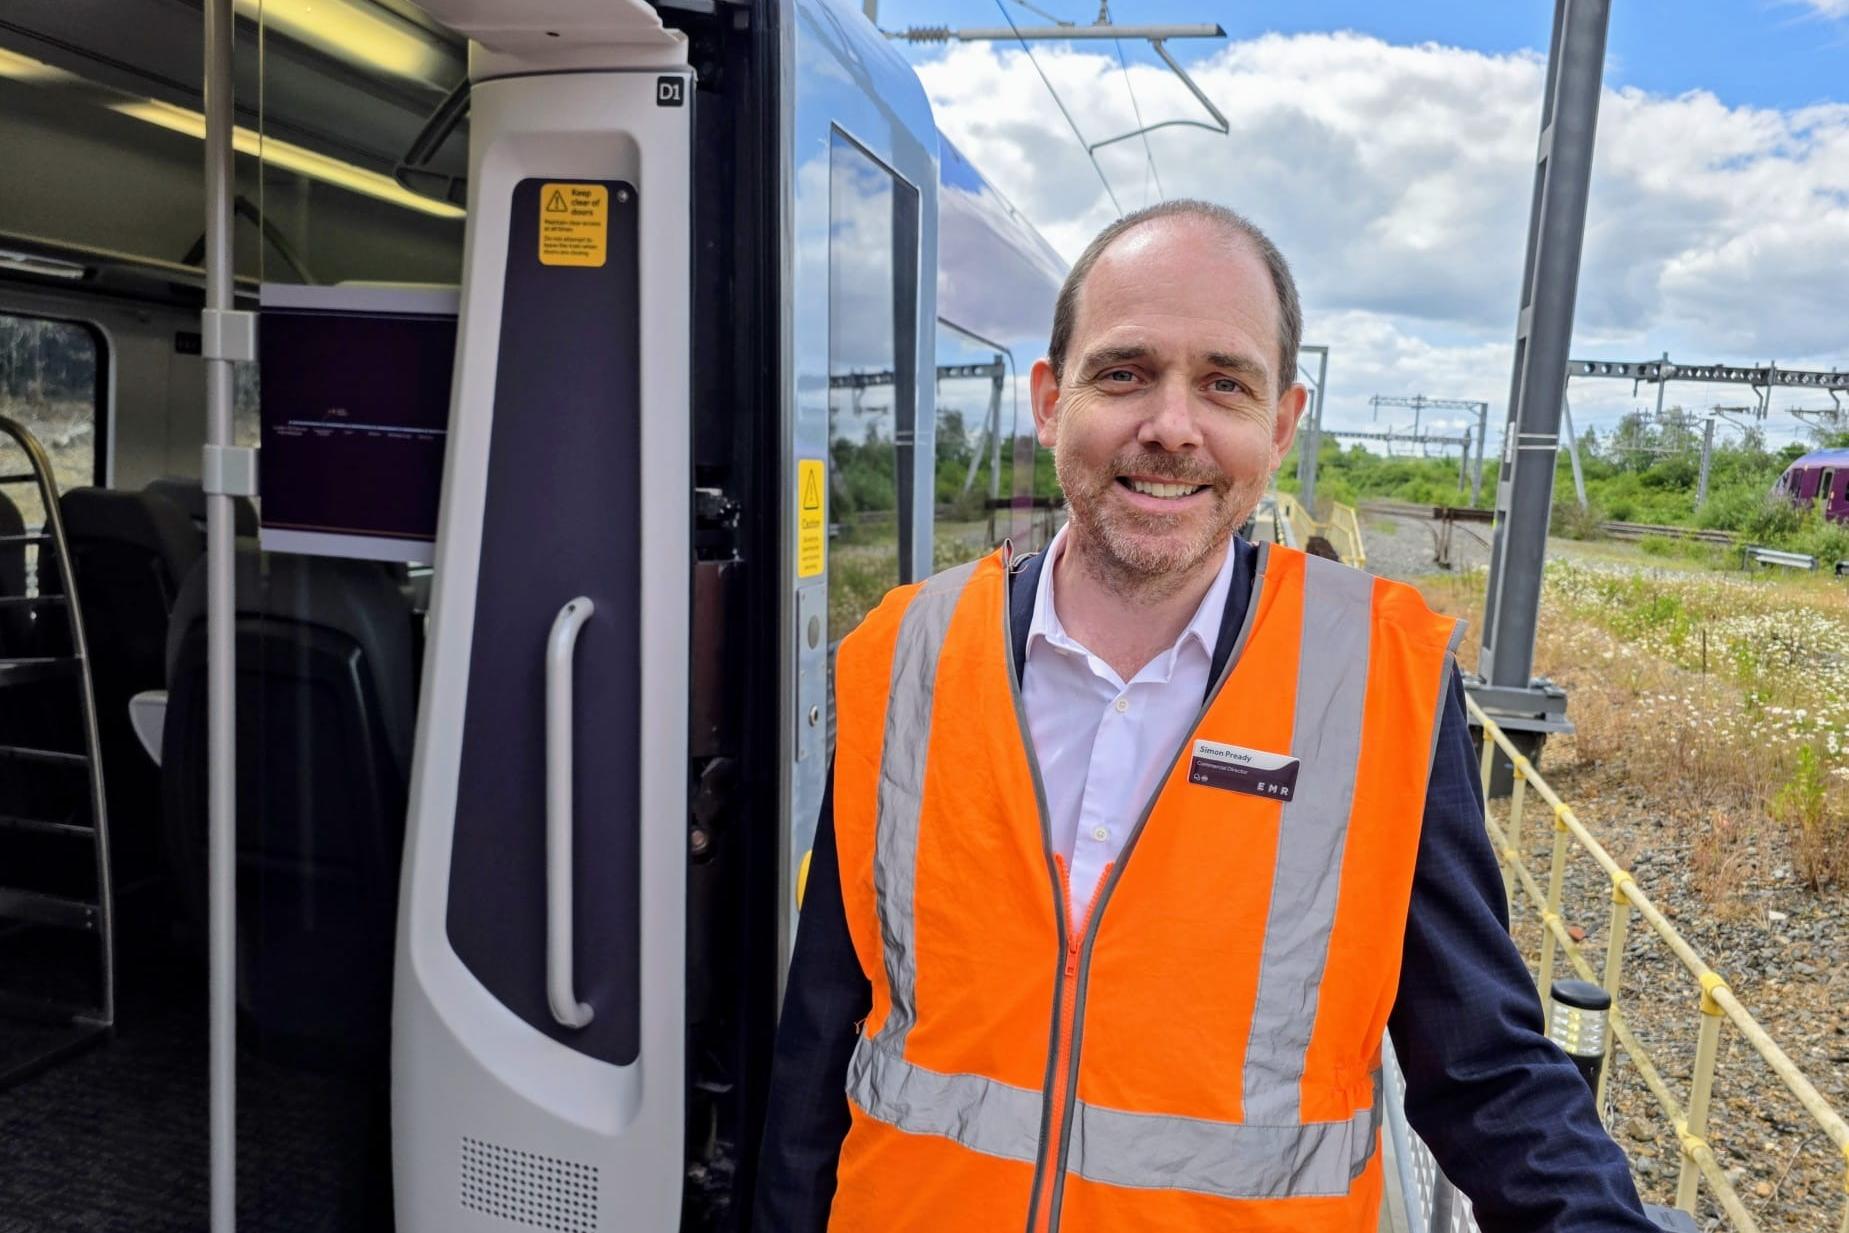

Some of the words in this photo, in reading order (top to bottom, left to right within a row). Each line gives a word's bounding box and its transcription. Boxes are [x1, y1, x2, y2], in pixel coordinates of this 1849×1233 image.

[660, 83, 680, 100] D1
[571, 189, 592, 198] Keep
[571, 199, 590, 207] clear
[592, 199, 601, 207] of
[571, 208, 594, 216] doors
[1200, 745, 1224, 757] Simon
[1225, 749, 1252, 763] Pready
[1196, 760, 1226, 770] Commercial
[1226, 766, 1249, 775] Director
